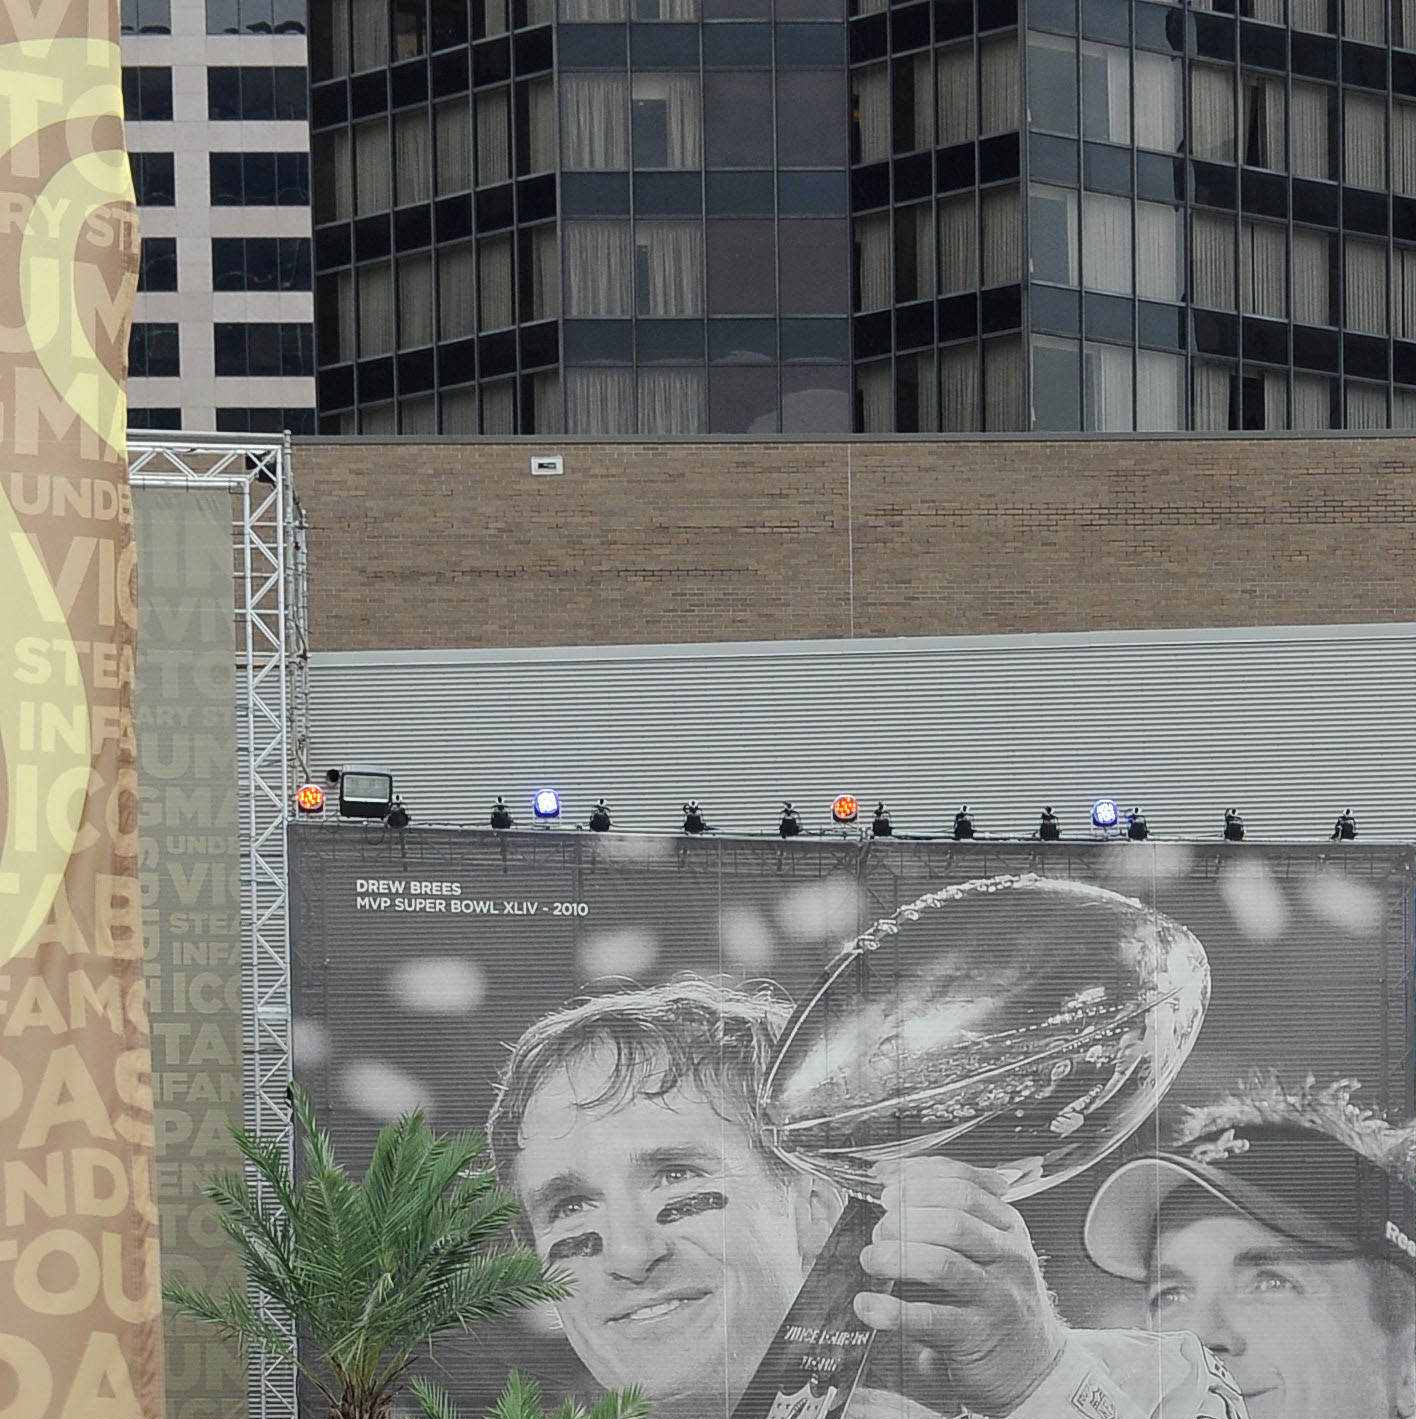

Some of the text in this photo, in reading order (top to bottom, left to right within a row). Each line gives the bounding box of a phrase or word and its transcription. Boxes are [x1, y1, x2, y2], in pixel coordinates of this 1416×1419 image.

[356, 879, 462, 896] DREW BREES
[357, 897, 589, 916] MVP SUPER BOWL XLIV 2010
